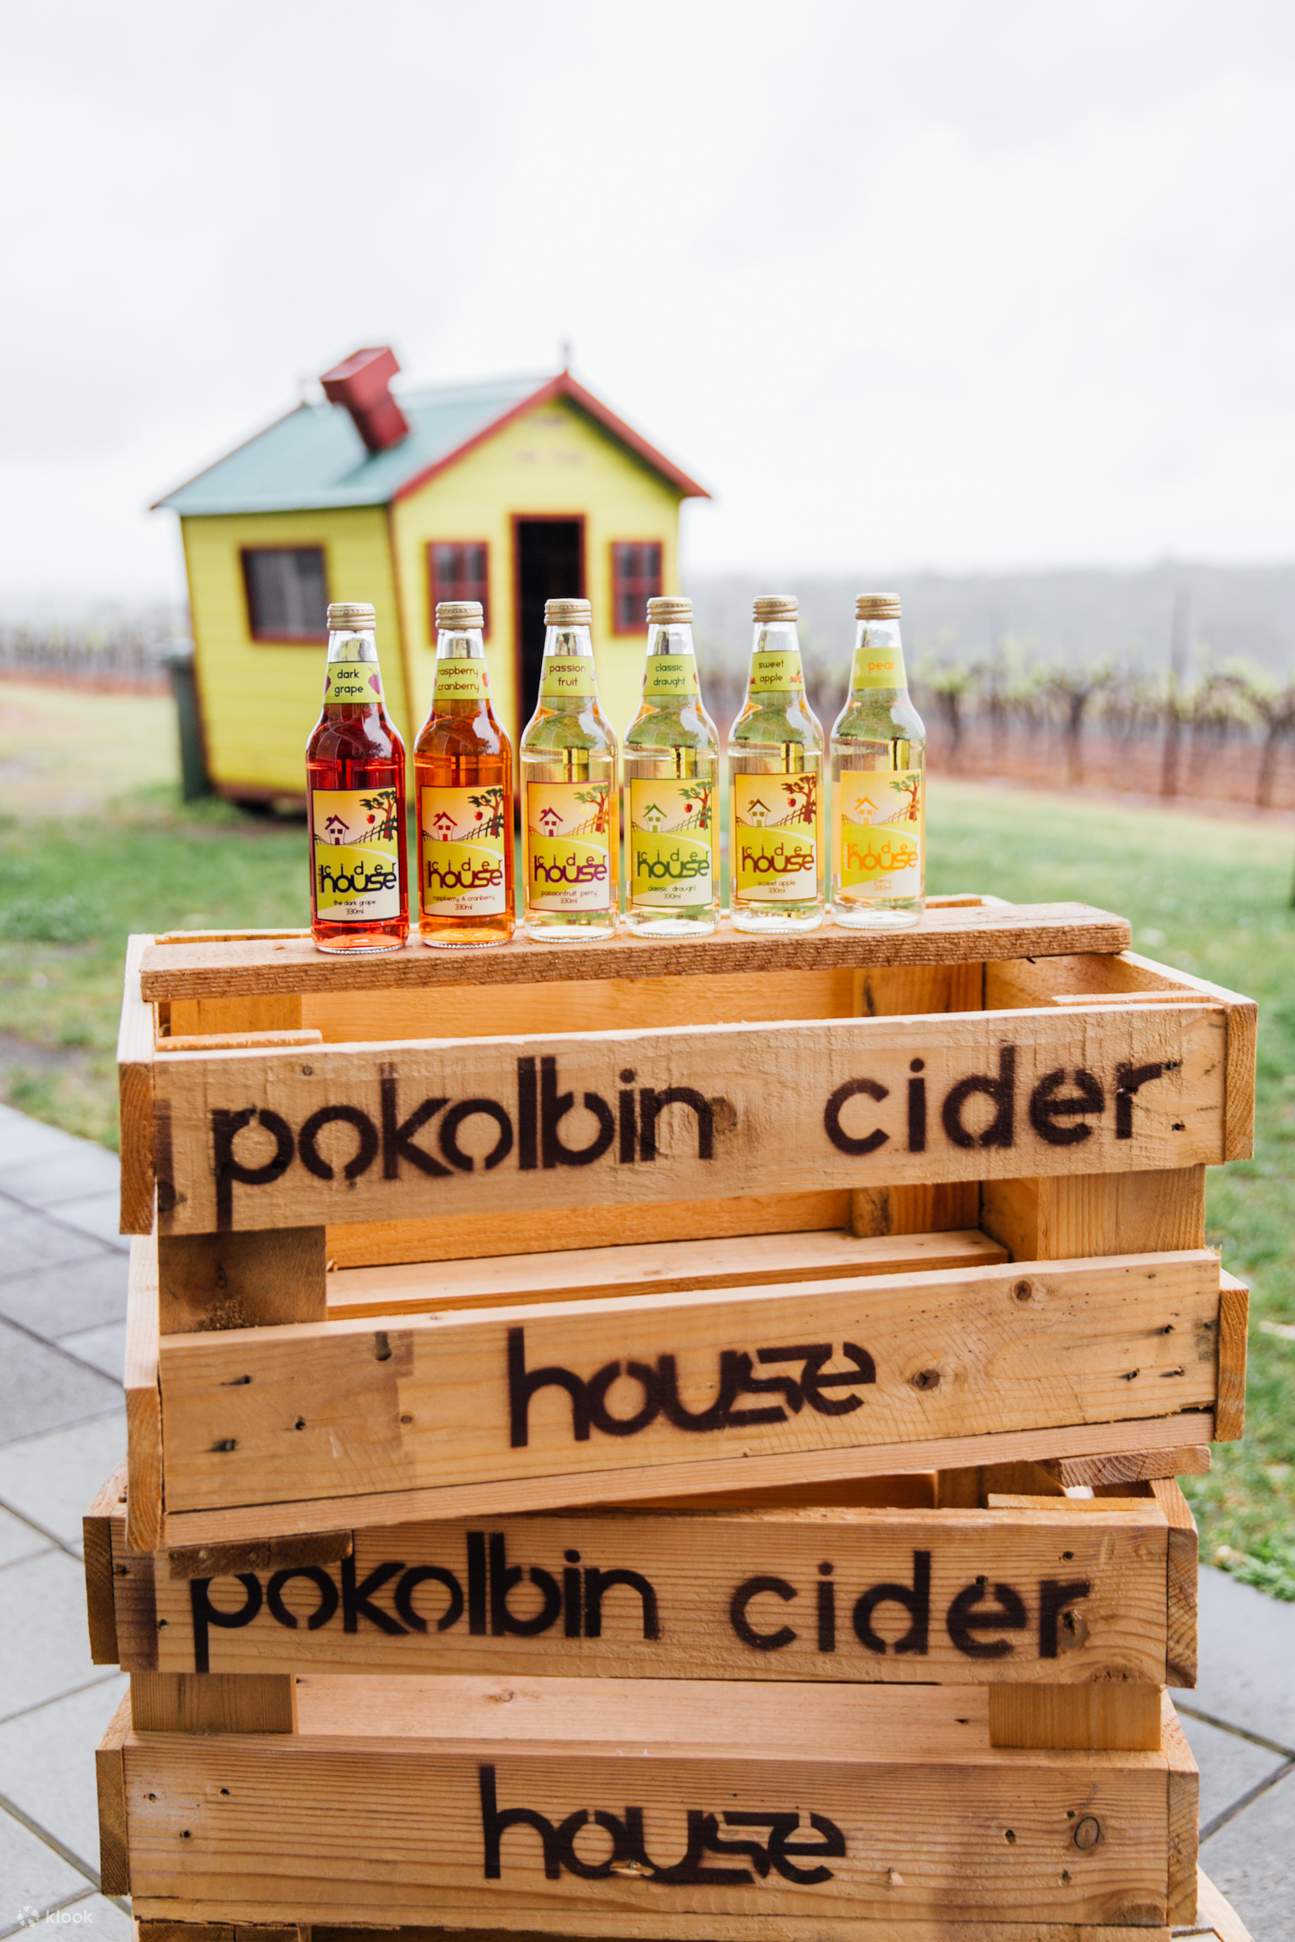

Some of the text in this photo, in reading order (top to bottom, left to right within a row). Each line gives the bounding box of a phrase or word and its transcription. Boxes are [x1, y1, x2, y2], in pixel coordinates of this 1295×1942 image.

[549, 663, 586, 675] passion
[655, 663, 684, 672] classic
[758, 659, 784, 669] sweet
[336, 668, 360, 679] dark
[557, 676, 578, 687] fruit
[652, 676, 686, 687] draught
[759, 673, 783, 684] apple
[334, 685, 364, 697] grape
[640, 848, 709, 863] cider
[744, 842, 814, 858] cider
[847, 842, 918, 871] house
[431, 857, 503, 874] cider
[538, 851, 607, 869] cider
[637, 851, 710, 878] house
[742, 845, 814, 873] house
[324, 860, 397, 876] cider
[428, 860, 503, 888] house
[534, 855, 607, 882] house
[319, 864, 397, 893] house
[211, 1045, 1181, 1232] pokolbin cider
[507, 1326, 876, 1448] house
[190, 1532, 1091, 1674] pokolbin cider
[479, 1764, 847, 1885] house
